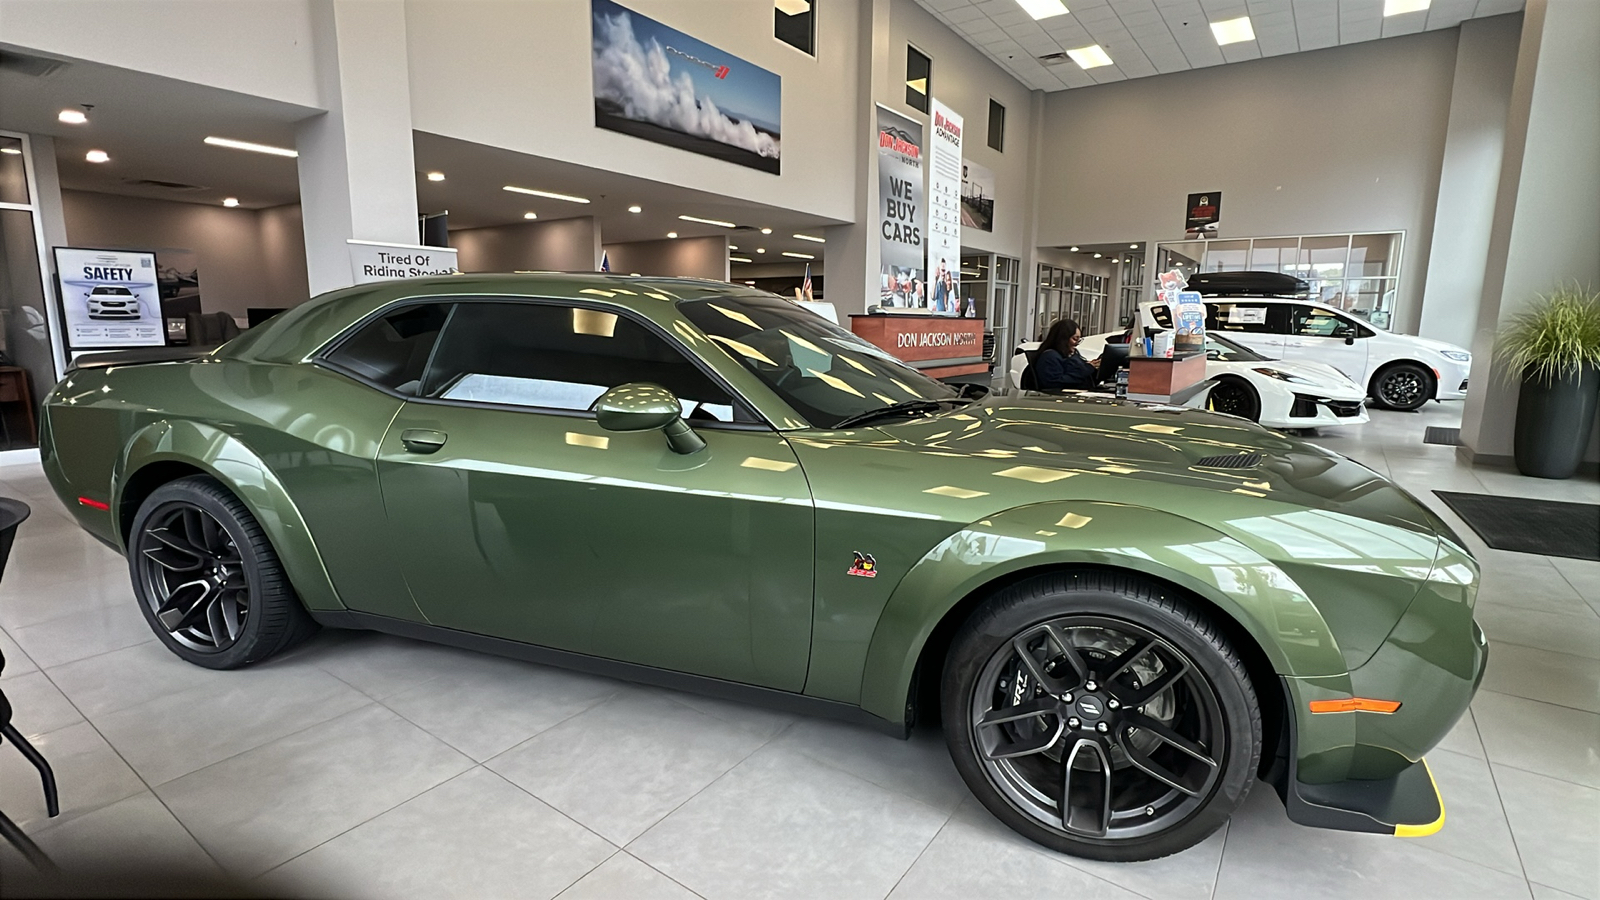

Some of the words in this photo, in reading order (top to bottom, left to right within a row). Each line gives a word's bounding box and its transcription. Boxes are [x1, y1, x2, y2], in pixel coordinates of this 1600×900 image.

[934, 110, 944, 129] DON
[880, 130, 894, 149] DON
[893, 136, 920, 159] JACKSON
[901, 156, 919, 169] NORTH
[889, 175, 913, 201] WE
[886, 198, 916, 223] BUY
[882, 220, 921, 246] CARS
[378, 252, 412, 265] Tired
[415, 255, 430, 267] Of
[83, 266, 133, 281] SAFETY
[363, 265, 406, 279] Riding
[897, 332, 918, 348] DON
[918, 332, 952, 347] JACKSON
[953, 332, 976, 346] NORTH
